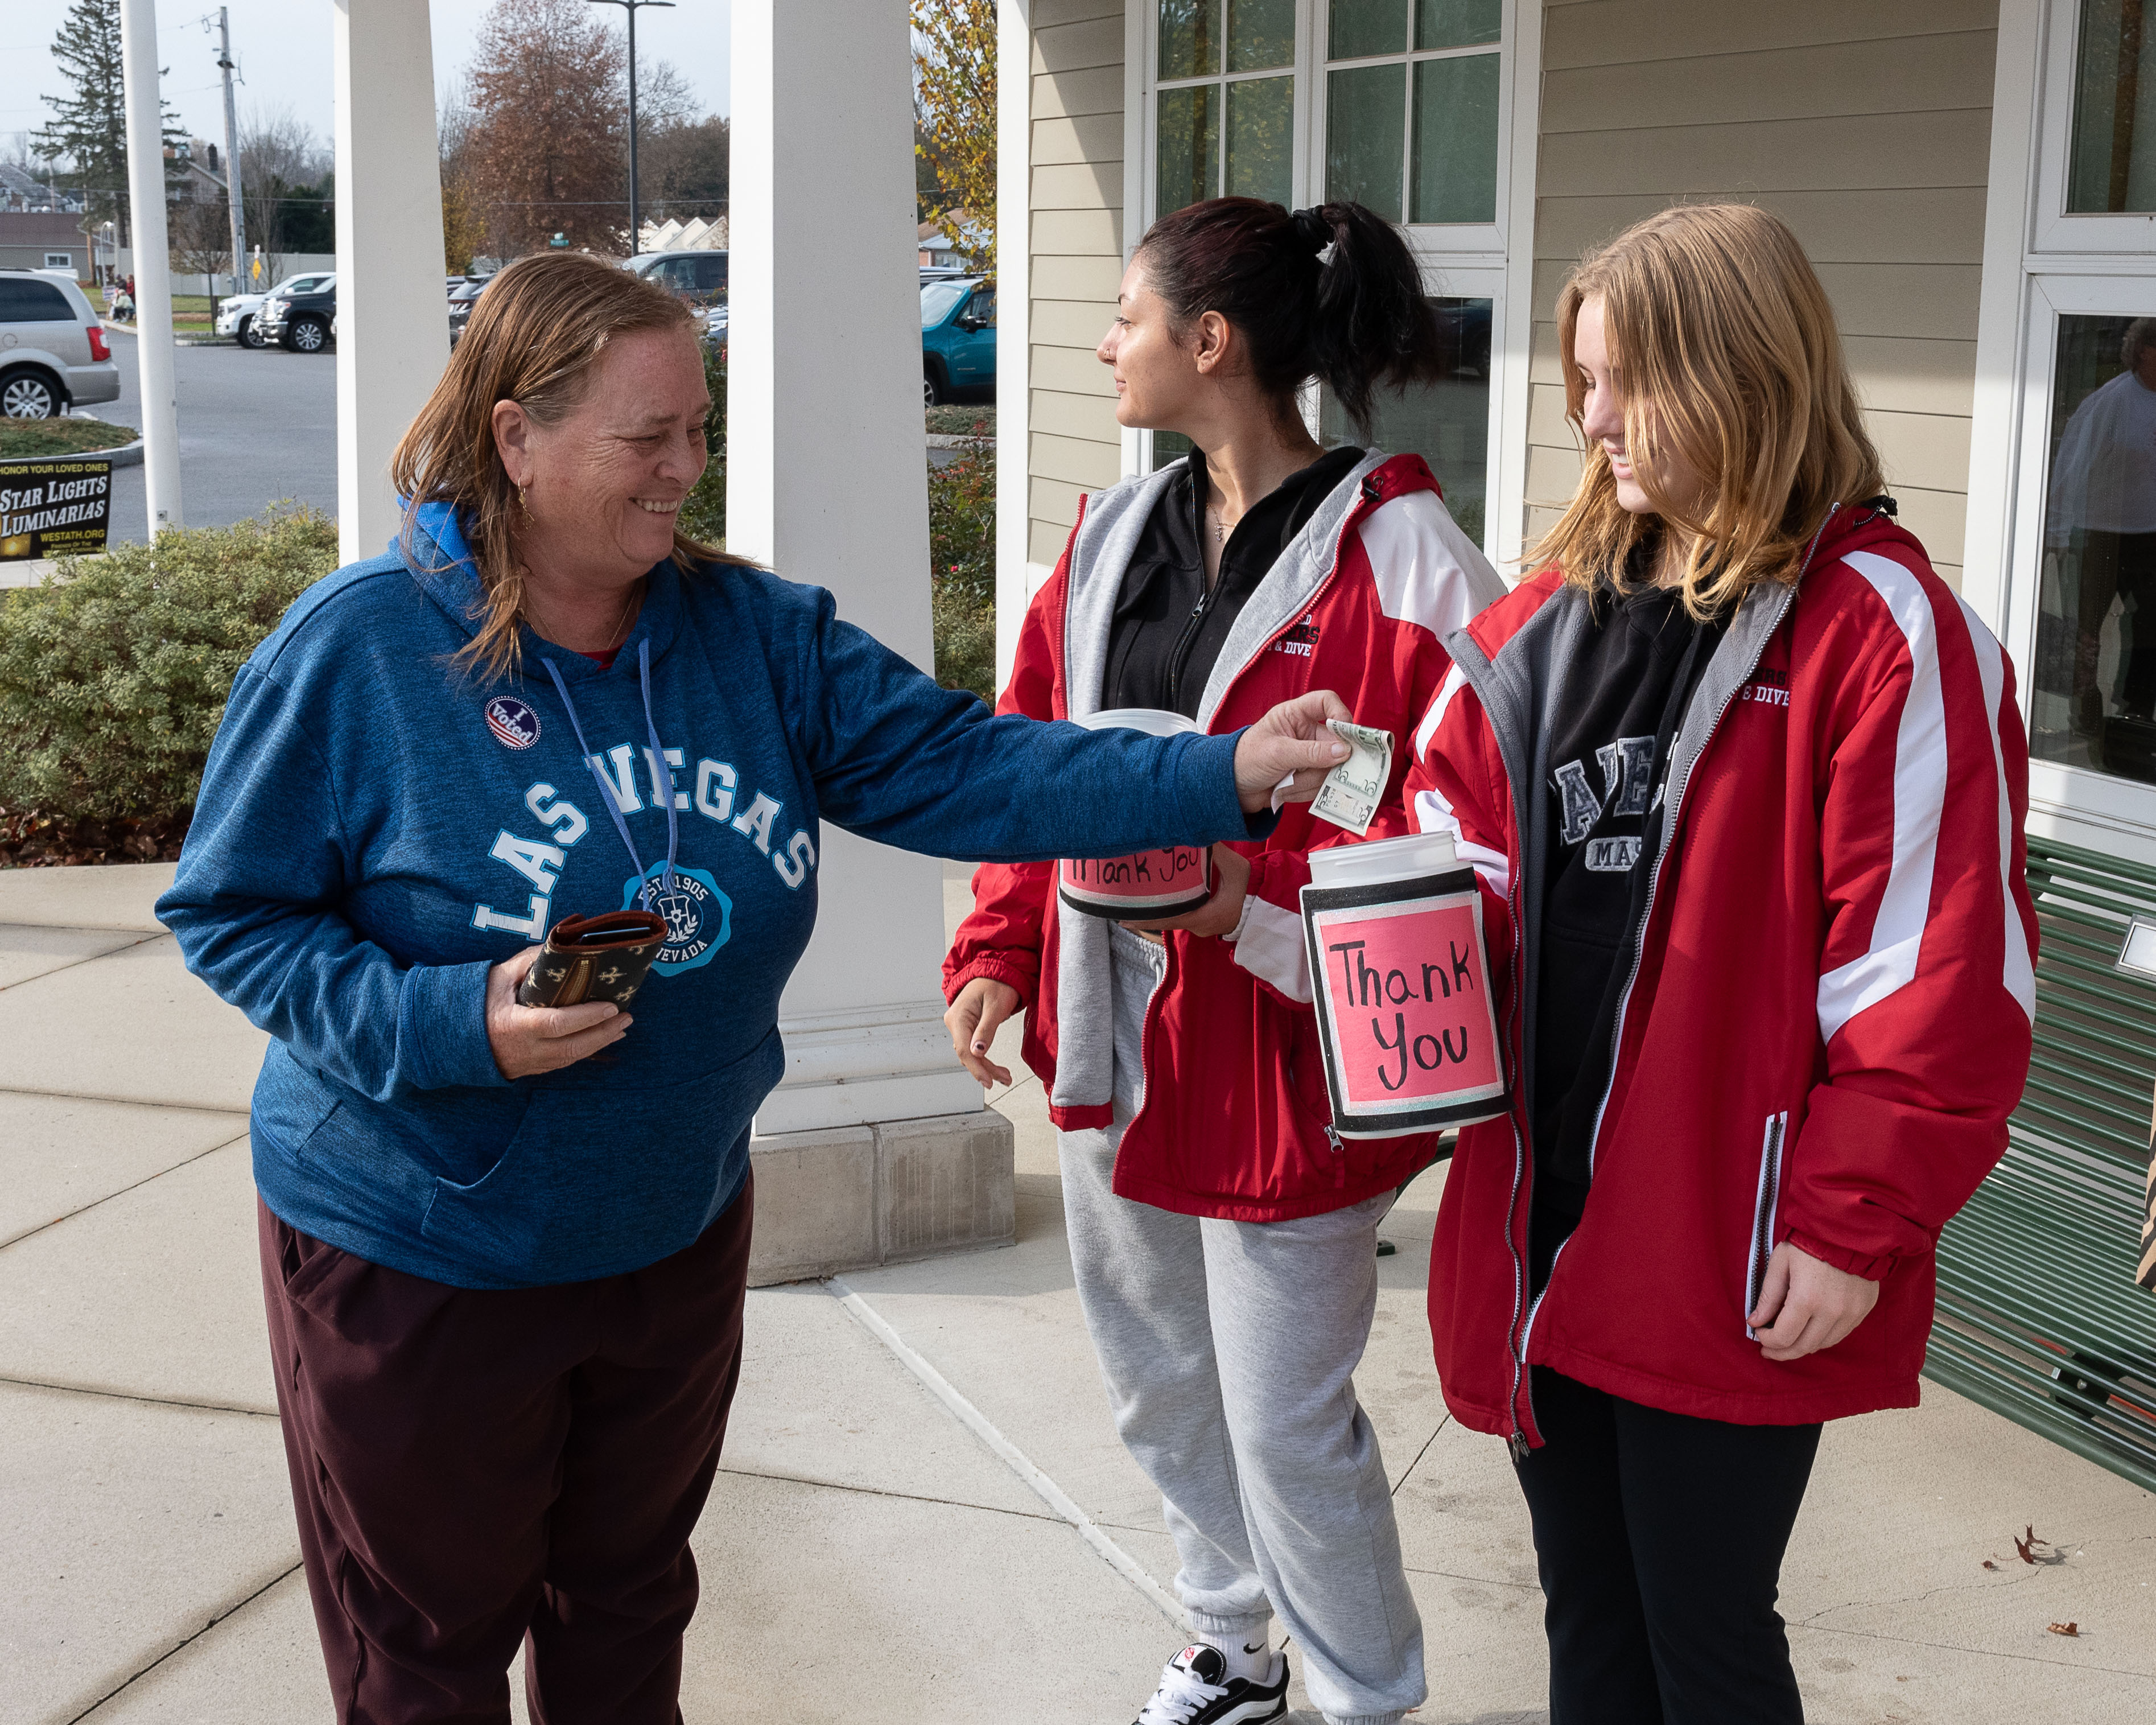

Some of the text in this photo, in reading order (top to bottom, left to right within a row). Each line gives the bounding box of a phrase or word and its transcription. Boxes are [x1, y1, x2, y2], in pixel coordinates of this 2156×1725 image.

[85, 463, 108, 472] ONES
[46, 476, 108, 504] LIGHTS
[1, 500, 105, 537] LUMINARIAS
[40, 530, 105, 542] WESTATH.ORG
[1280, 625, 1320, 644] ERS
[1284, 642, 1312, 657] DIVE
[492, 702, 534, 744] Voted
[513, 707, 528, 722] I
[1361, 779, 1378, 796] 5
[470, 742, 816, 941] LAS VEGAS
[675, 875, 709, 901] 1905
[1329, 940, 1474, 1008] Thank
